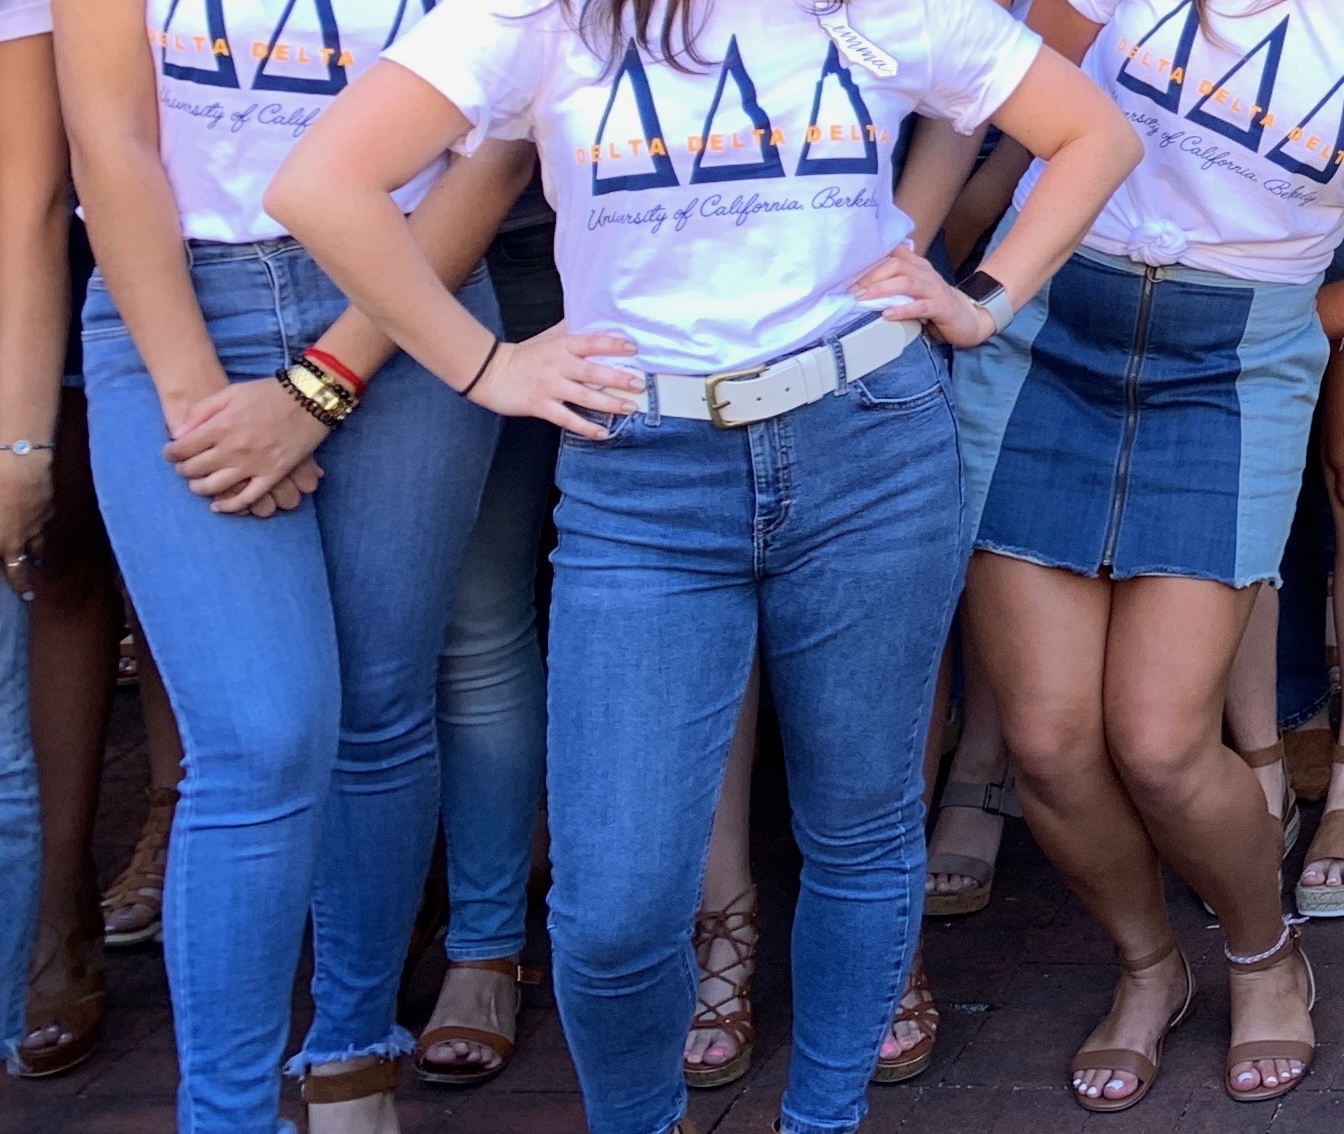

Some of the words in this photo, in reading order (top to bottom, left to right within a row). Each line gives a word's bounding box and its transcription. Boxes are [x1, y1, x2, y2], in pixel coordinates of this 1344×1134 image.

[251, 40, 355, 67] DELTA
[1117, 37, 1185, 85] DELTA
[1198, 78, 1275, 129] DELTA
[230, 102, 257, 133] of
[257, 103, 321, 138] Calif
[575, 136, 667, 166] DELTA
[687, 128, 786, 154] DELTA
[806, 123, 890, 144] DELTA
[1160, 131, 1185, 148] of
[587, 204, 668, 235] University
[673, 197, 699, 232] of
